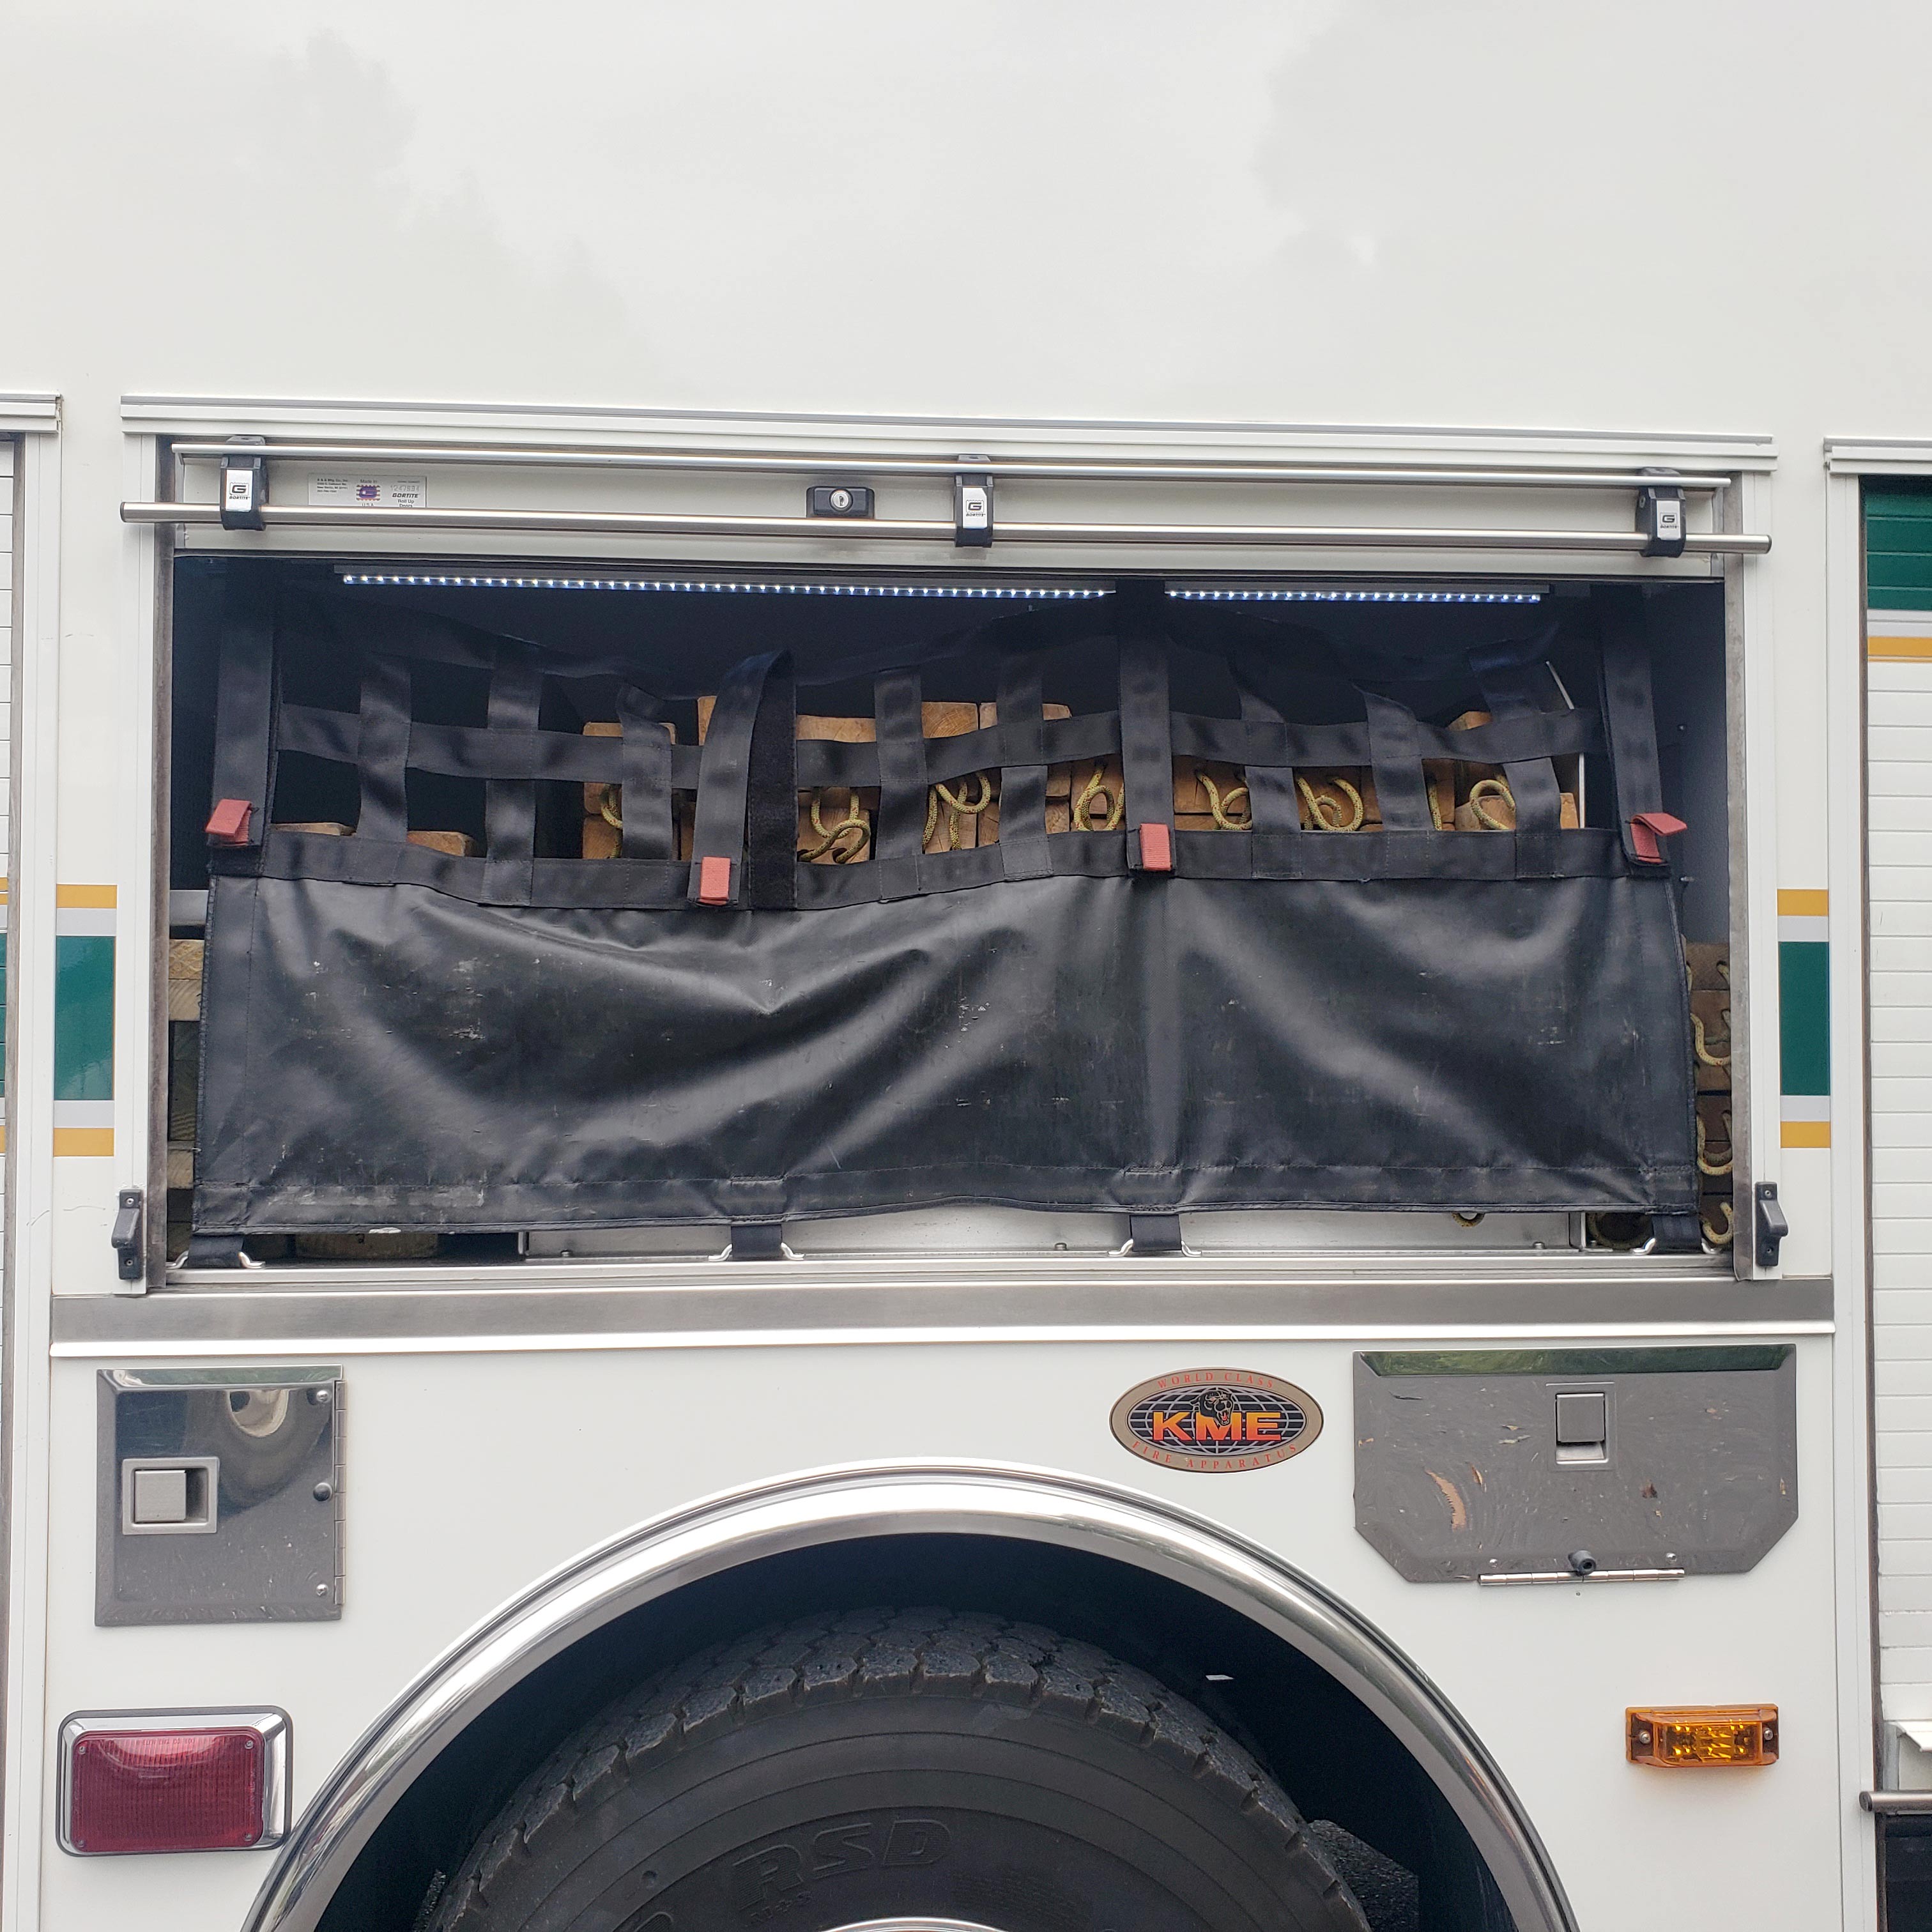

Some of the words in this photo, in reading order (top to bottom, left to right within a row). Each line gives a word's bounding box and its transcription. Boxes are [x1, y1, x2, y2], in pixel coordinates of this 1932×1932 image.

[1157, 1372, 1214, 1389] WORLD
[1225, 1372, 1274, 1389] CLASS
[1151, 1411, 1282, 1441] KME
[1131, 1441, 1172, 1463] FIRE
[1186, 1443, 1297, 1469] APPARATUS
[732, 1819, 952, 1911] RSD
